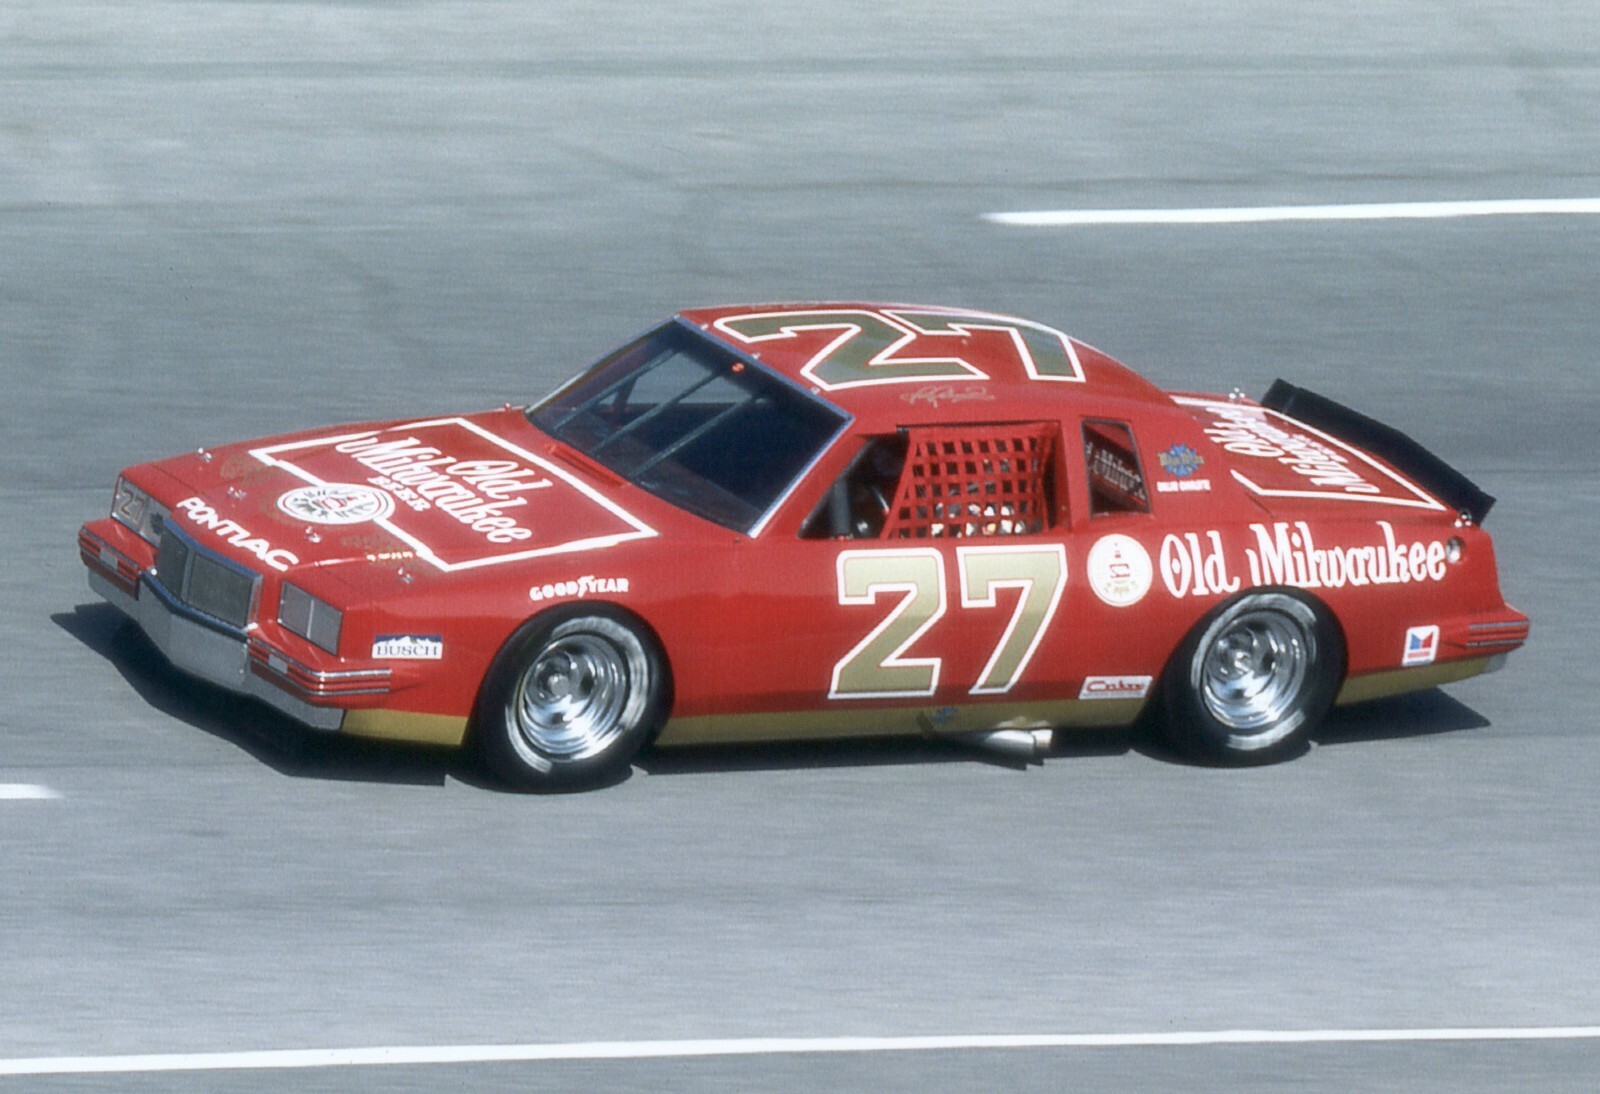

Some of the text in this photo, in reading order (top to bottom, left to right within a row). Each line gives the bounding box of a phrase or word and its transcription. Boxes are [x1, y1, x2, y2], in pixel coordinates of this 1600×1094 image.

[714, 310, 1086, 391] 27
[119, 487, 147, 527] 27
[335, 437, 532, 543] Milwaukee
[446, 460, 553, 500] Old
[176, 497, 299, 572] PONTIAC
[1160, 530, 1240, 598] Old
[1245, 521, 1447, 588] Milwaukee
[530, 575, 629, 601] GOODYEAR
[827, 543, 1069, 699] 27
[377, 646, 437, 656] BUSCH
